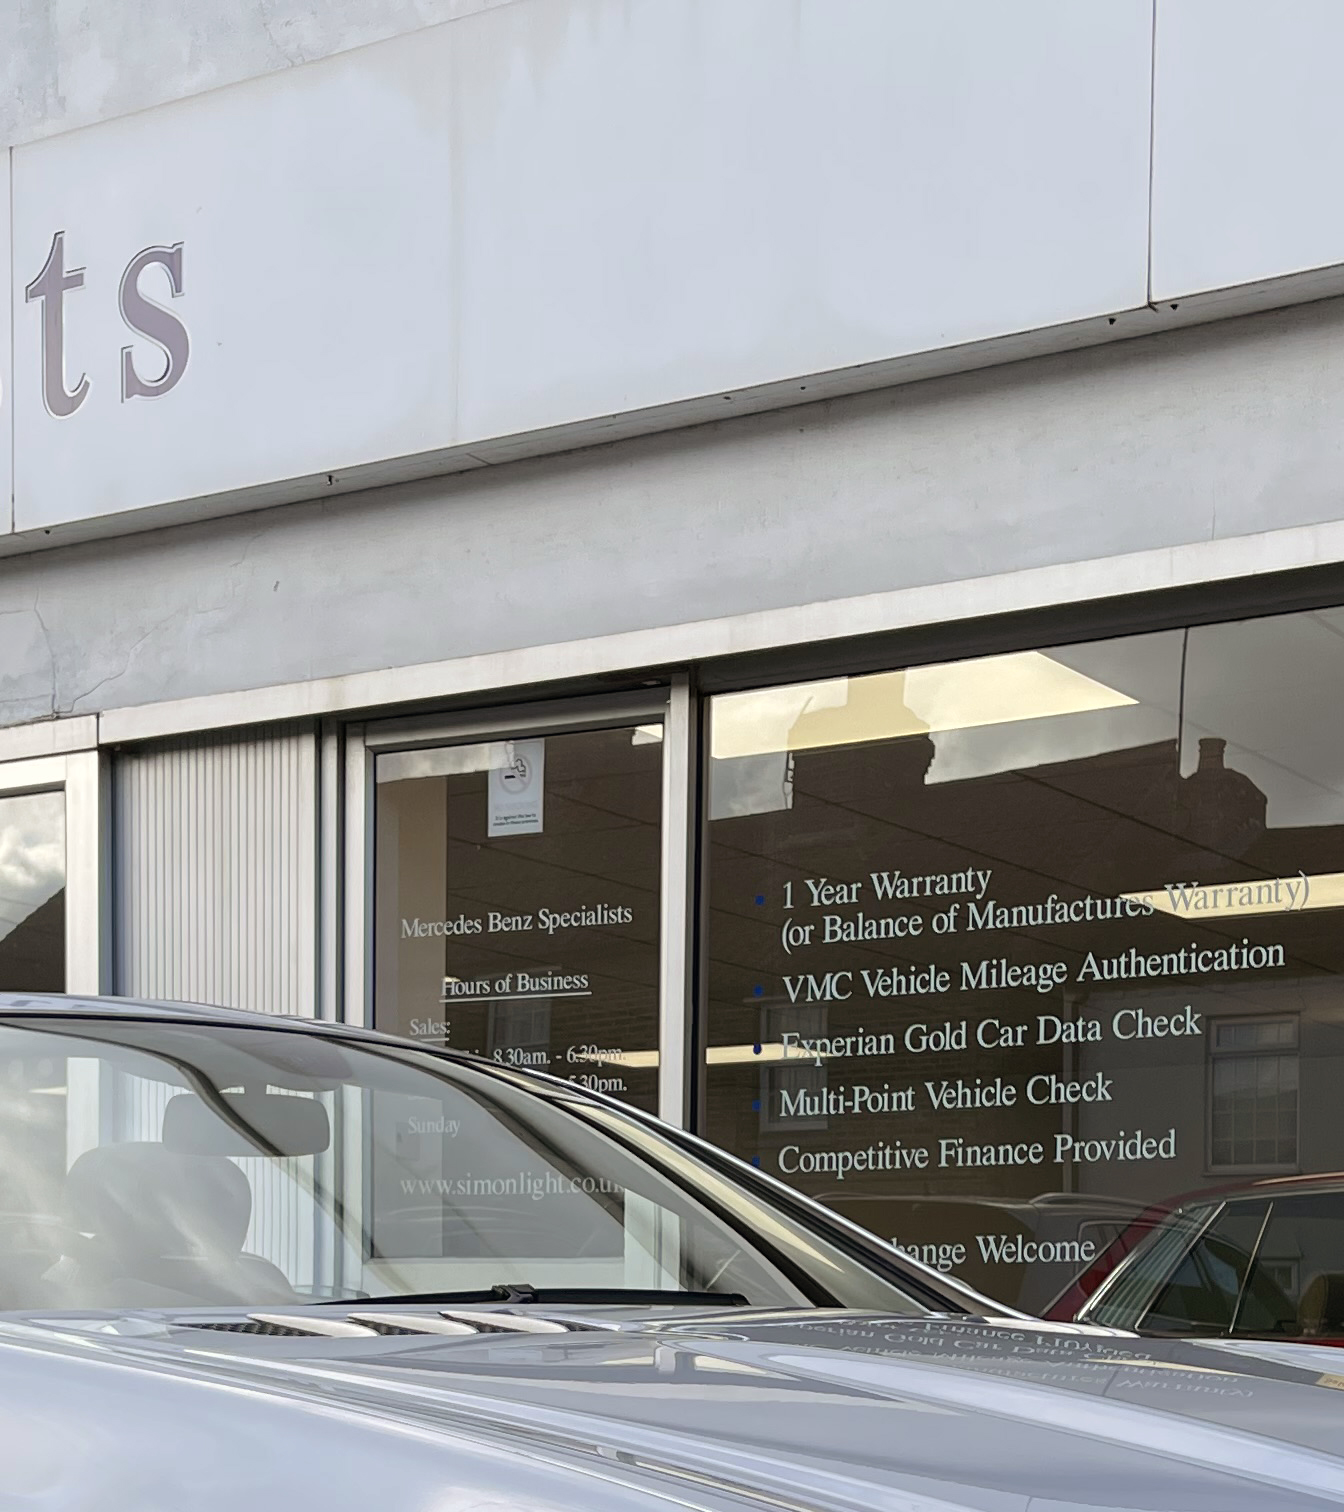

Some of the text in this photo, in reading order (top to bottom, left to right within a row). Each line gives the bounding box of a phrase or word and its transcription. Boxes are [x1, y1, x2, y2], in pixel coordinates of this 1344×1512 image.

[783, 867, 992, 909] 1 Year Warranty
[401, 903, 633, 939] Mercedes Benz Specialists
[782, 870, 1310, 954] (or Balance of Manufactures Warranty)
[442, 972, 589, 997] Hours of Business
[782, 938, 1285, 1003] VMC Vehicle Mileage Authentication
[409, 1018, 451, 1036] Sales:
[781, 1005, 1202, 1067] Experian Gold Car Data Check
[493, 1048, 551, 1066] 830am.
[779, 1072, 1113, 1117] Multi-Point Vehicle Check
[408, 1116, 461, 1137] Sunday
[778, 1128, 1176, 1180] Competitive Finance Provided
[892, 1234, 1096, 1273] hange Welcome
